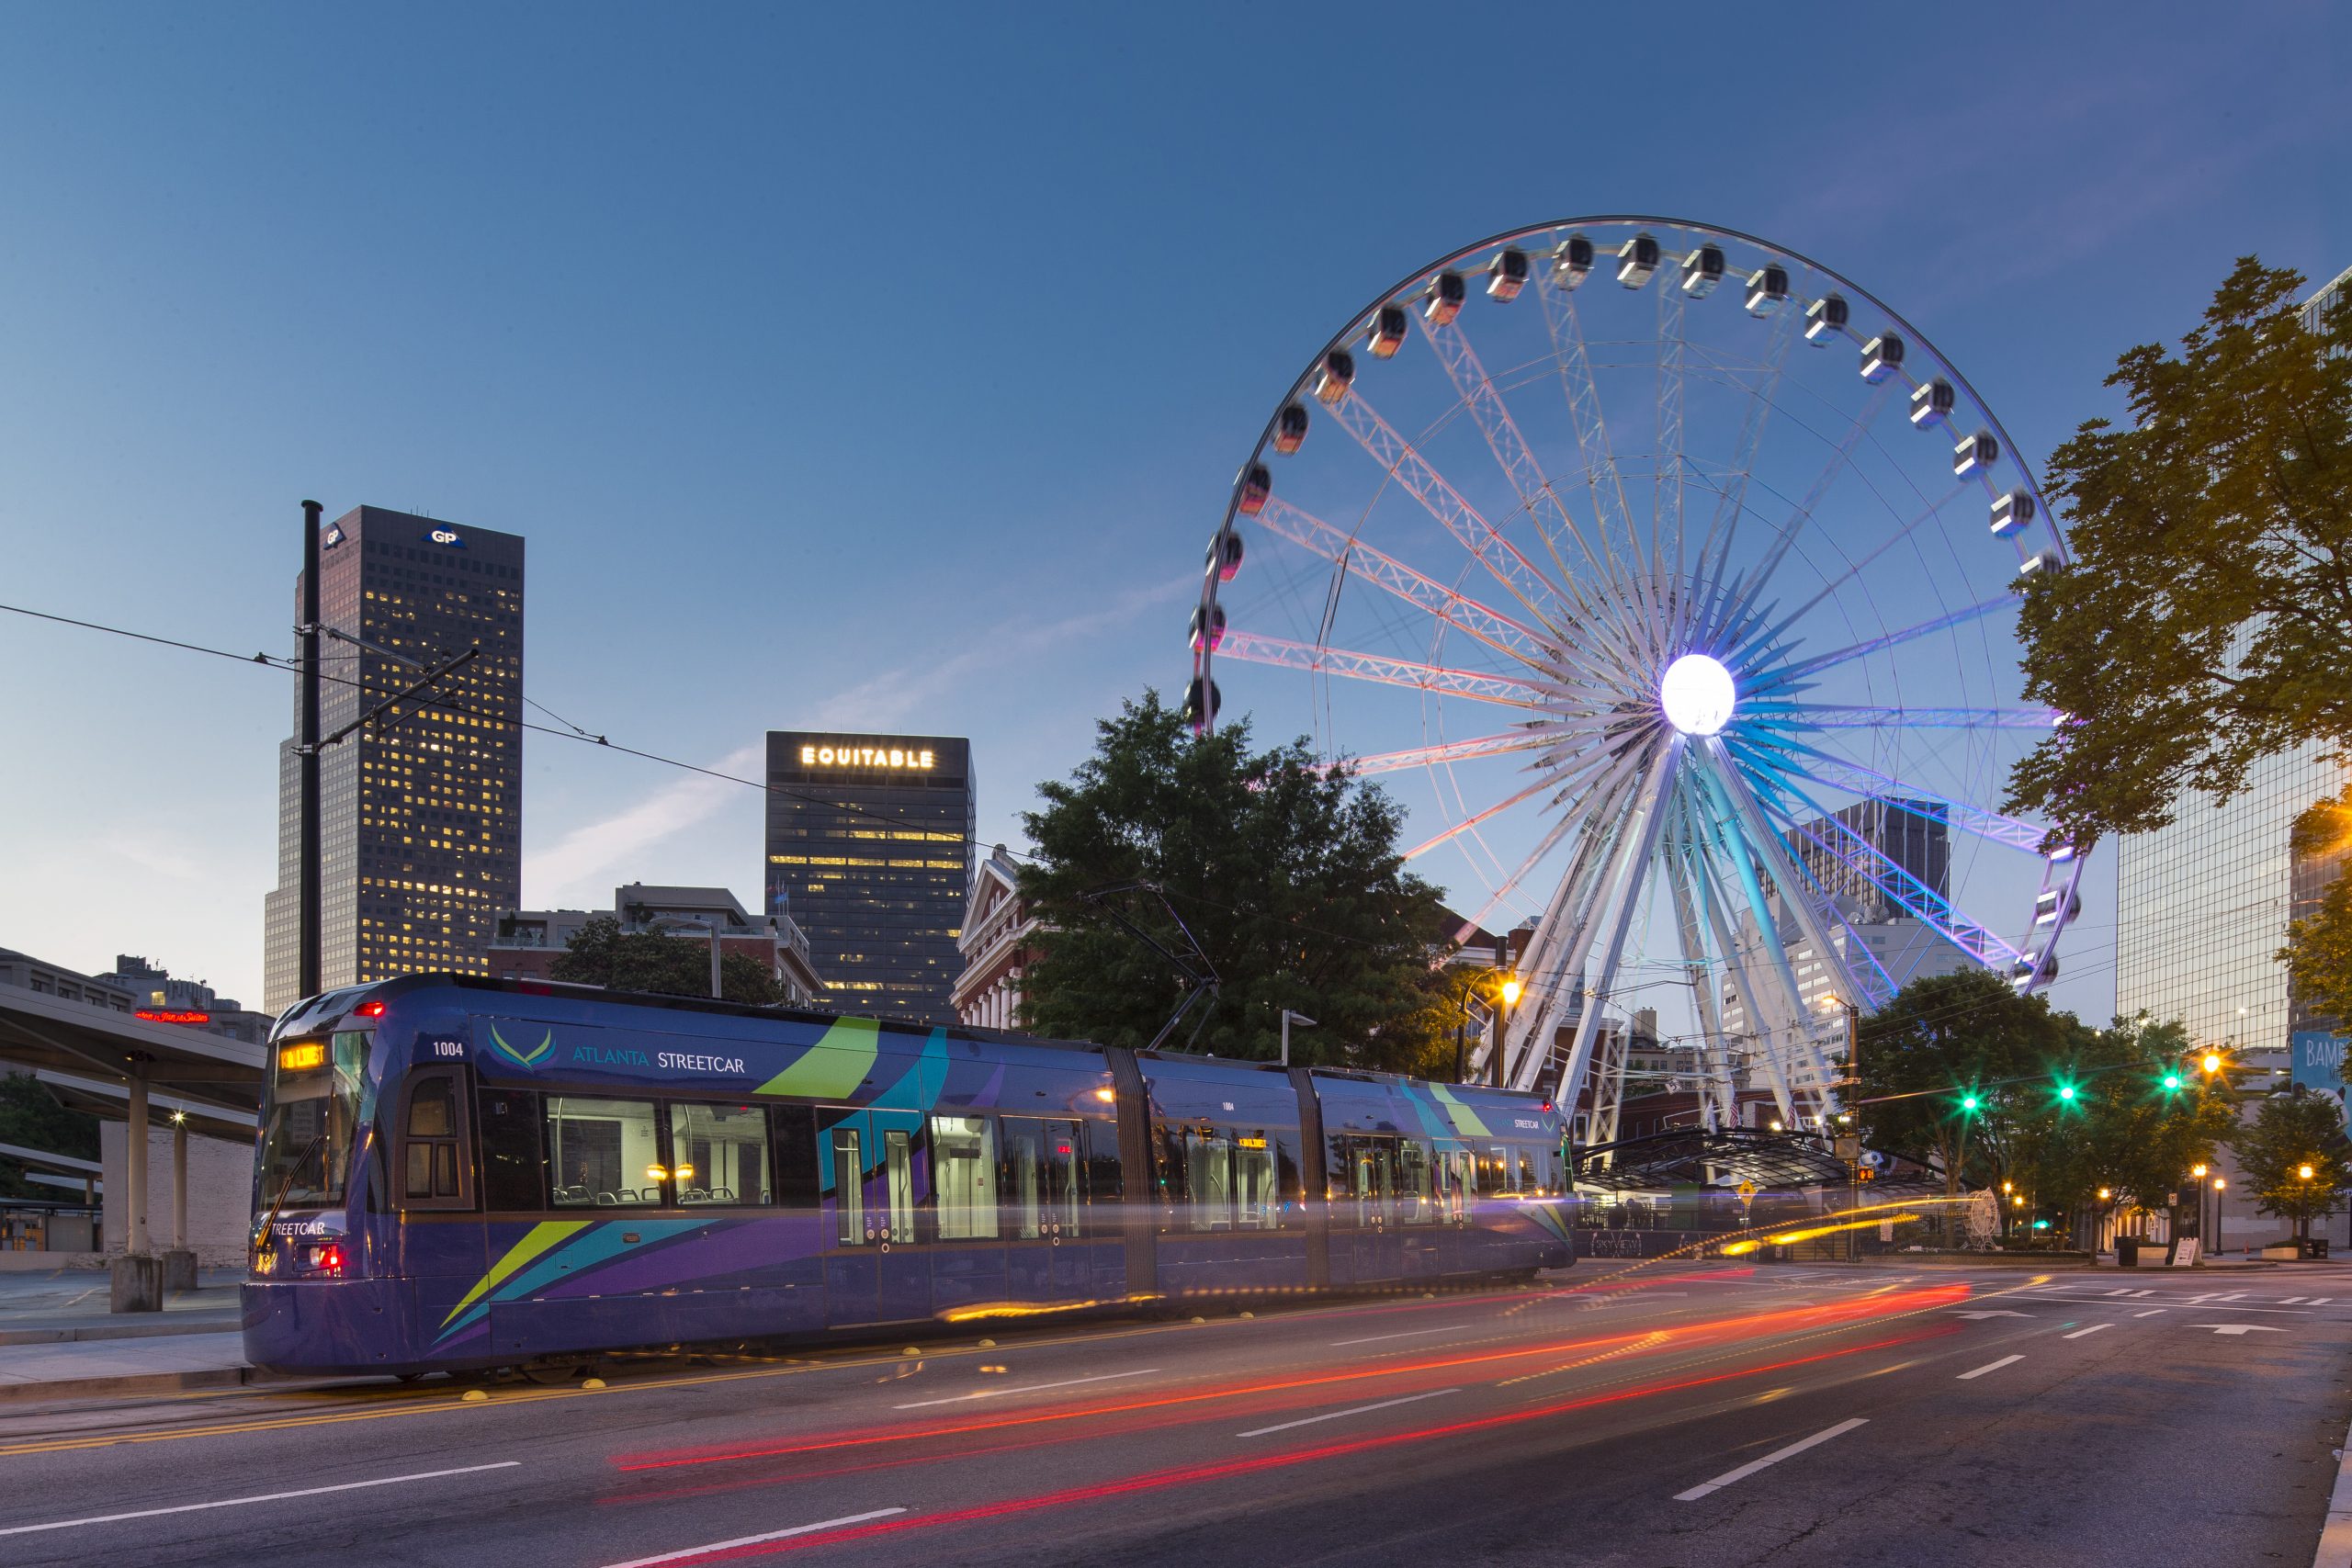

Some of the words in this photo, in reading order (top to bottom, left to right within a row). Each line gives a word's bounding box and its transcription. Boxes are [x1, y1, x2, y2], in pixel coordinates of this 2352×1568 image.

[327, 529, 339, 545] GP
[431, 530, 457, 544] GP
[801, 746, 933, 768] EQUITABLE
[184, 1011, 209, 1021] Suites
[434, 1042, 464, 1056] 1004
[572, 1045, 650, 1066] ATLANTA
[658, 1052, 745, 1074] STREETCAR
[1514, 1119, 1539, 1129] STREETCAR
[272, 1223, 325, 1235] TREETCAR
